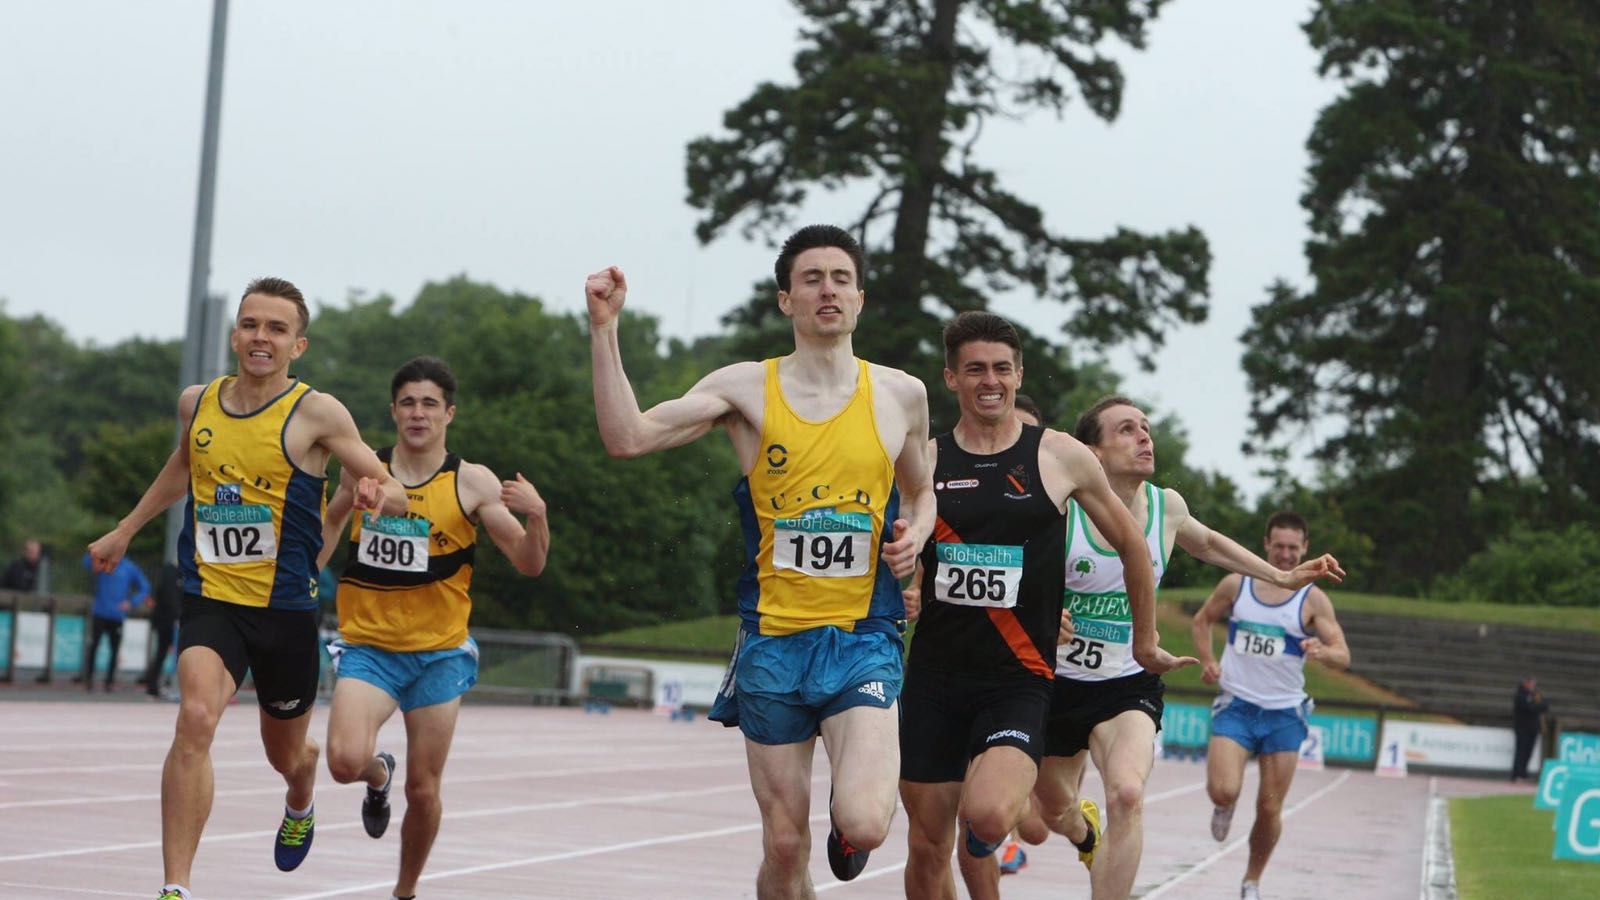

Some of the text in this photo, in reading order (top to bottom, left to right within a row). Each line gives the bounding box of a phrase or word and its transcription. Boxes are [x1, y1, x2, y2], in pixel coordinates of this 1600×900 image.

[202, 506, 262, 521] GloHealth
[786, 514, 861, 531] GloHealth
[208, 526, 263, 558] 102
[366, 535, 414, 566] 490
[790, 535, 854, 570] 194
[944, 546, 1012, 564] GloHealth
[947, 567, 1006, 601] 265
[1069, 594, 1130, 616] RAHEN
[1072, 621, 1121, 641] oHealth
[1066, 637, 1104, 669] 25
[1243, 634, 1275, 656] 156
[857, 686, 887, 703] adidas
[986, 729, 1017, 743] HOKA
[1303, 735, 1318, 757] 2
[1388, 741, 1398, 766] 1
